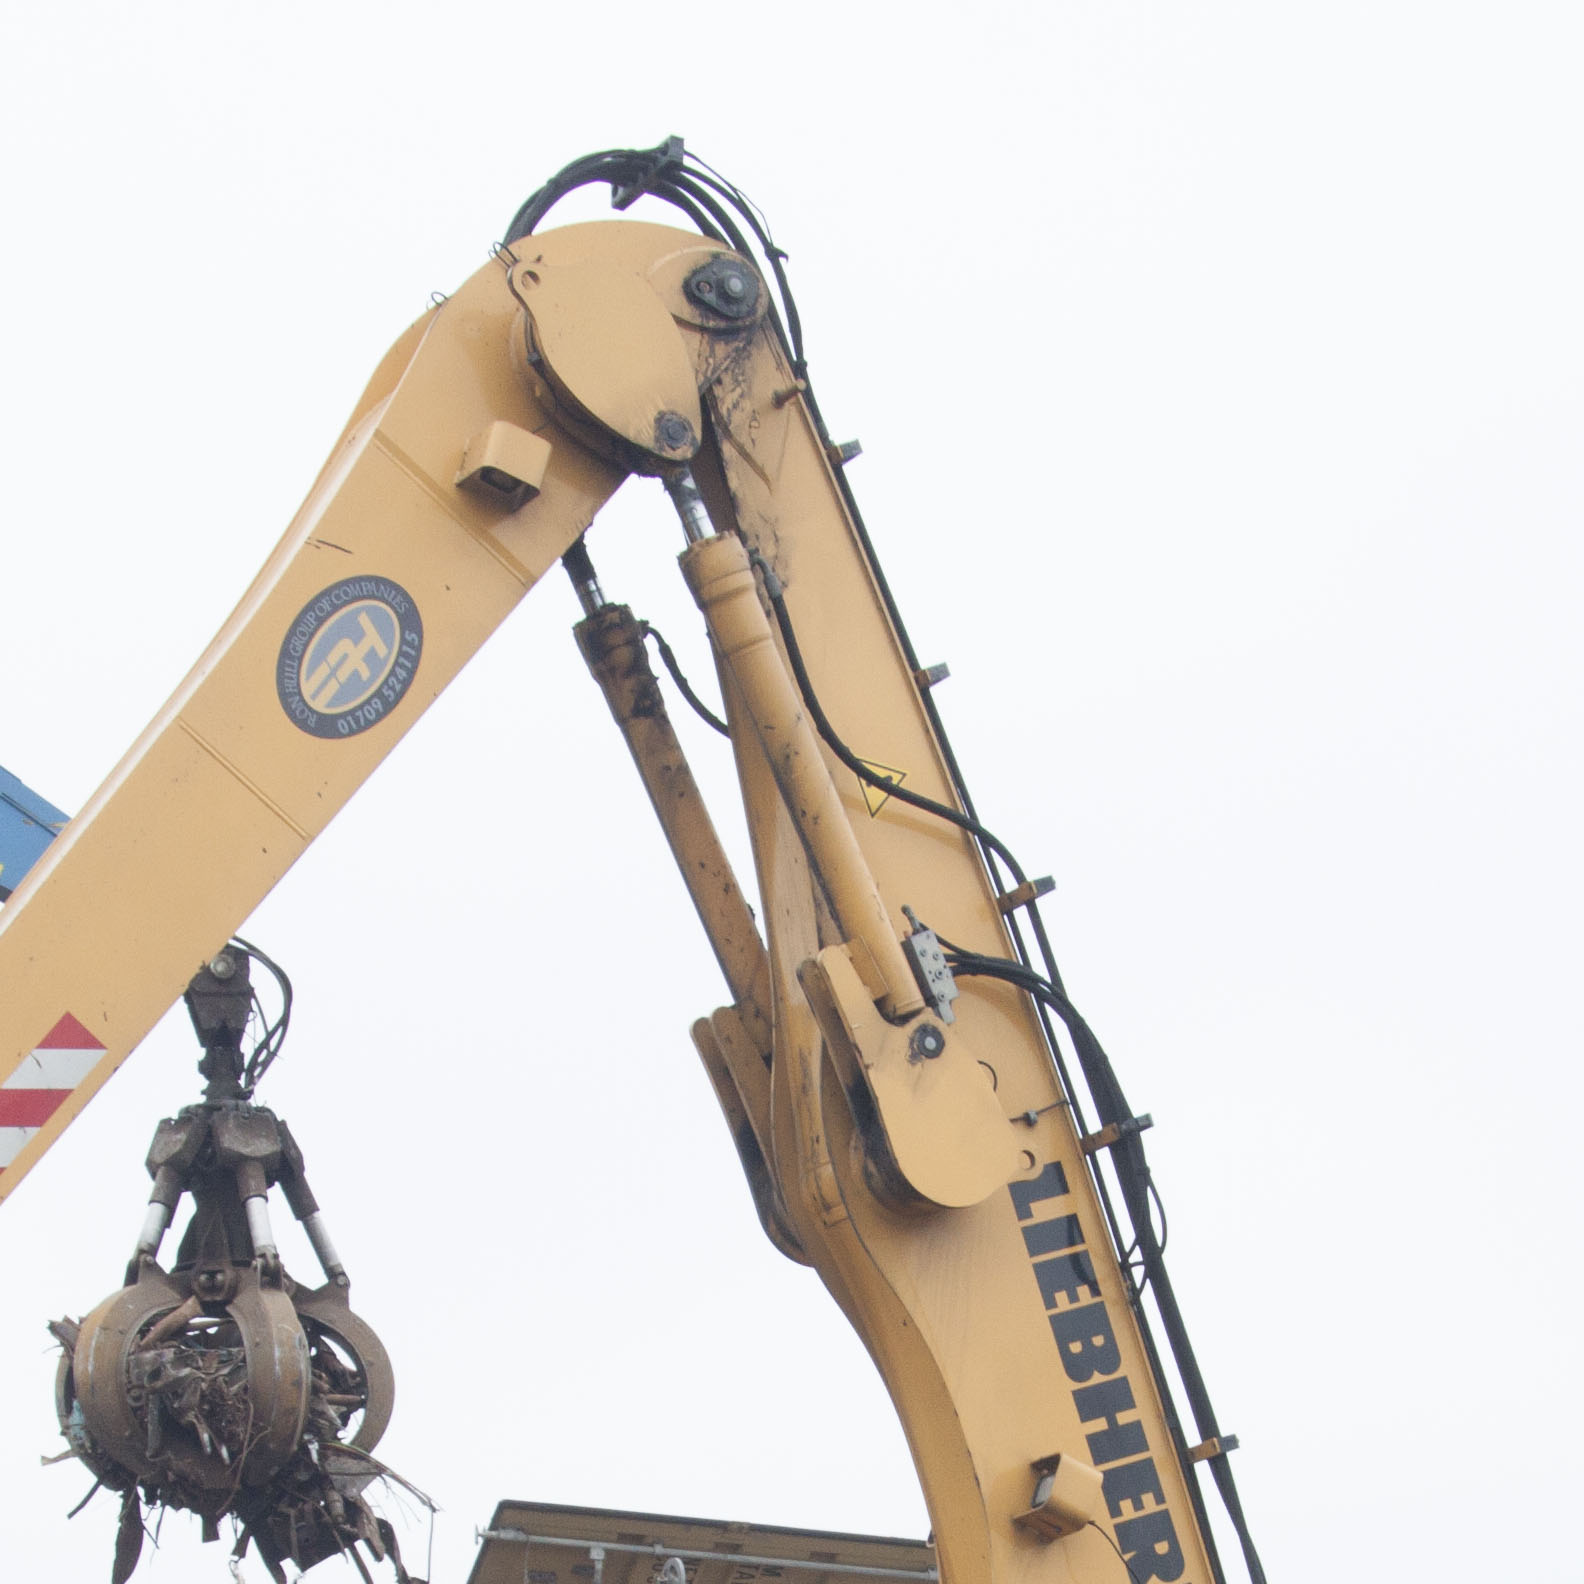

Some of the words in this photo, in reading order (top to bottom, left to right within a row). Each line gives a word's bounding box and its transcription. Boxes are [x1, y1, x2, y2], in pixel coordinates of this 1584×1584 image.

[314, 596, 332, 616] OF
[331, 582, 409, 613] COMPANIES
[289, 611, 316, 656] GROUP
[284, 657, 299, 693] HULL
[337, 697, 383, 734] 01709
[382, 630, 418, 702] 524115
[288, 695, 316, 728] RON
